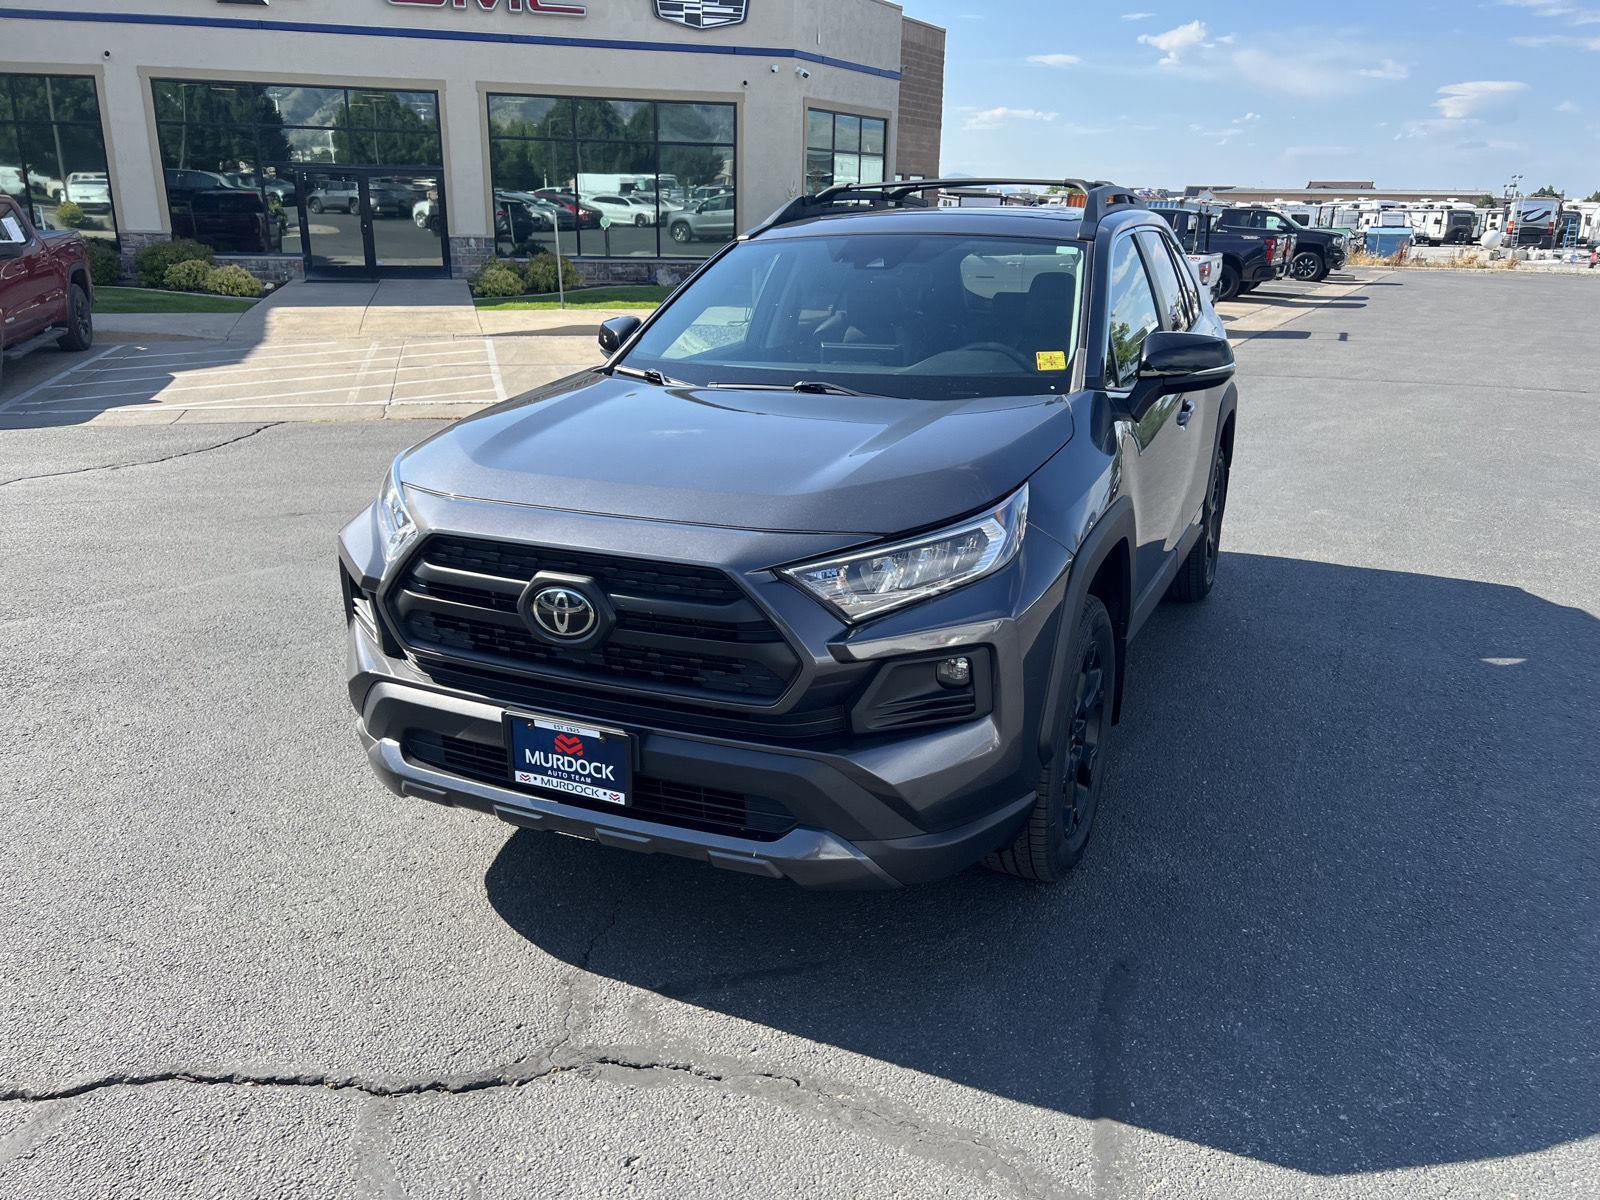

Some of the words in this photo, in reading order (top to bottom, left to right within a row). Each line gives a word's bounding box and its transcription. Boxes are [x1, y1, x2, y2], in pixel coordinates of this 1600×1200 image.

[525, 748, 615, 781] MURDOCK
[547, 769, 568, 779] AUTO
[571, 773, 592, 784] TEAM
[541, 777, 600, 798] MURDOCK
